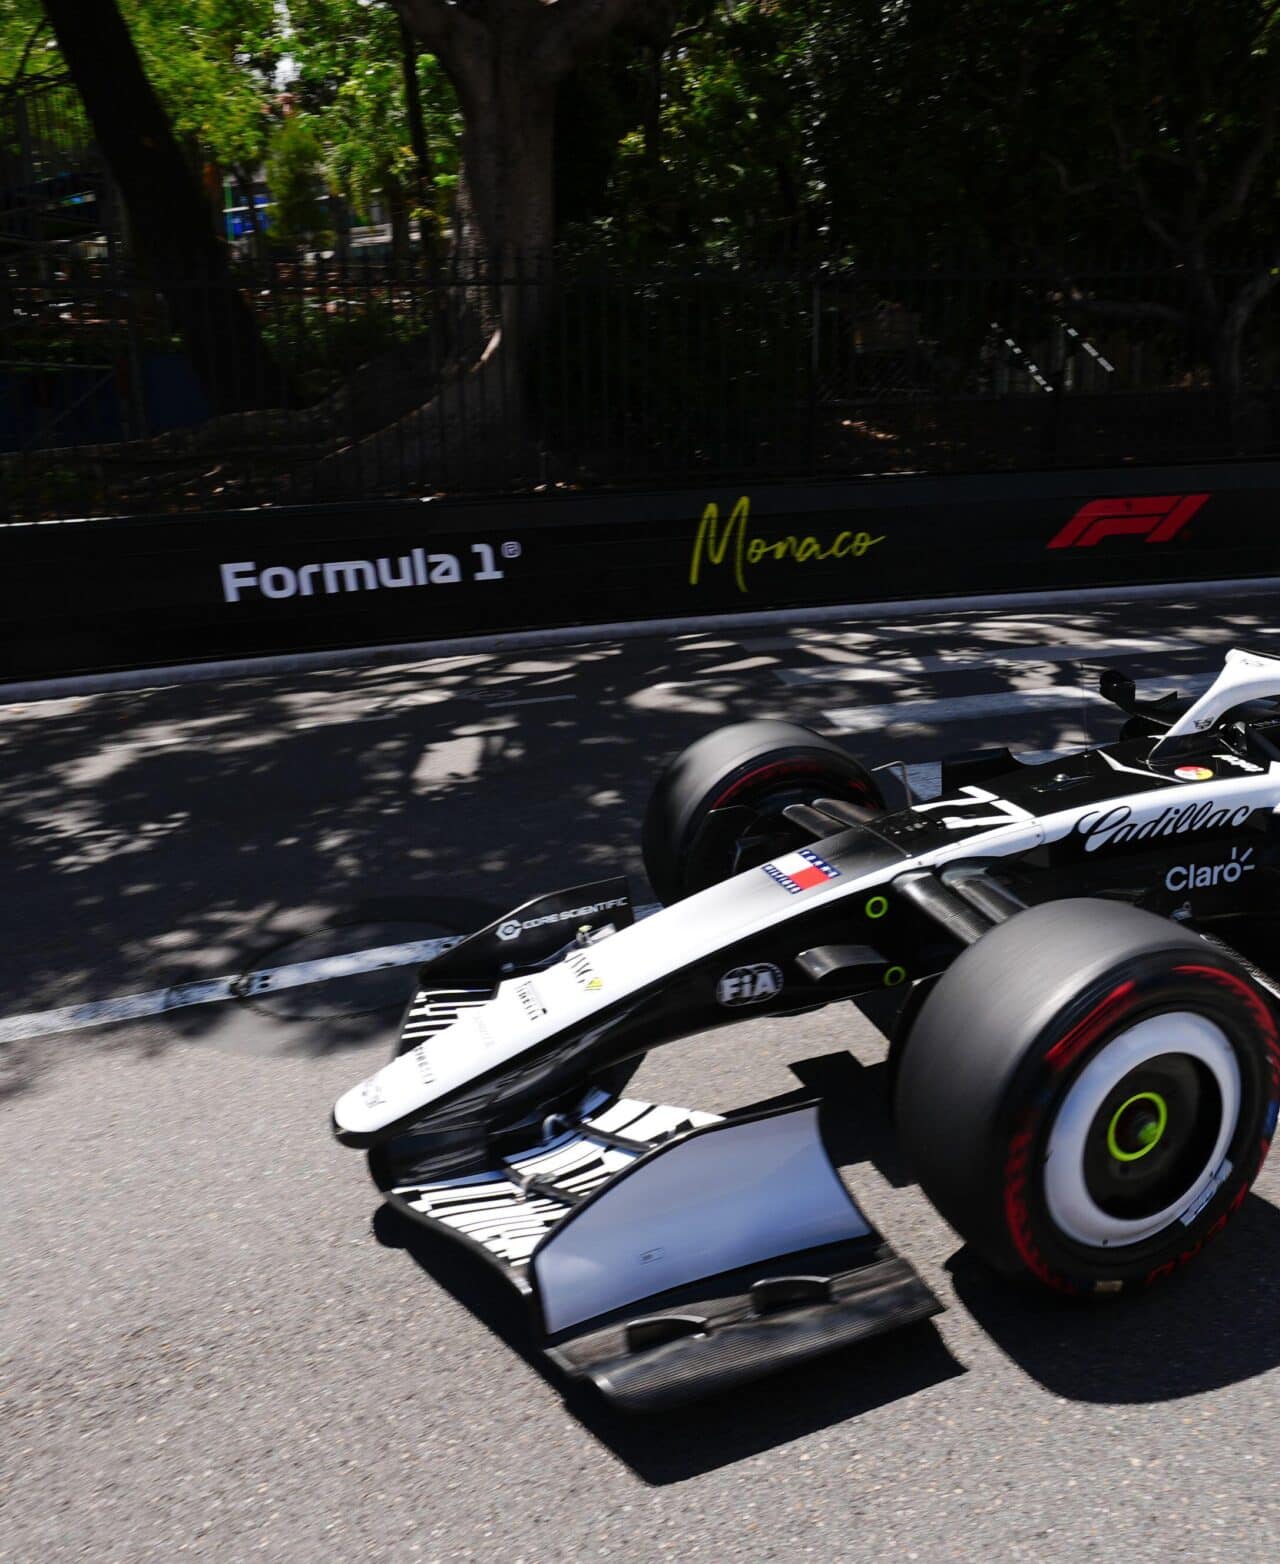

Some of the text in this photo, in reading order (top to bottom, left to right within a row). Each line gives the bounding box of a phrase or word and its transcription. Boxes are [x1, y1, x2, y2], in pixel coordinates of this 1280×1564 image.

[689, 496, 886, 592] Monaco
[220, 548, 461, 602] Formula
[1072, 800, 1254, 852] Cadillac
[1165, 857, 1244, 892] Claro
